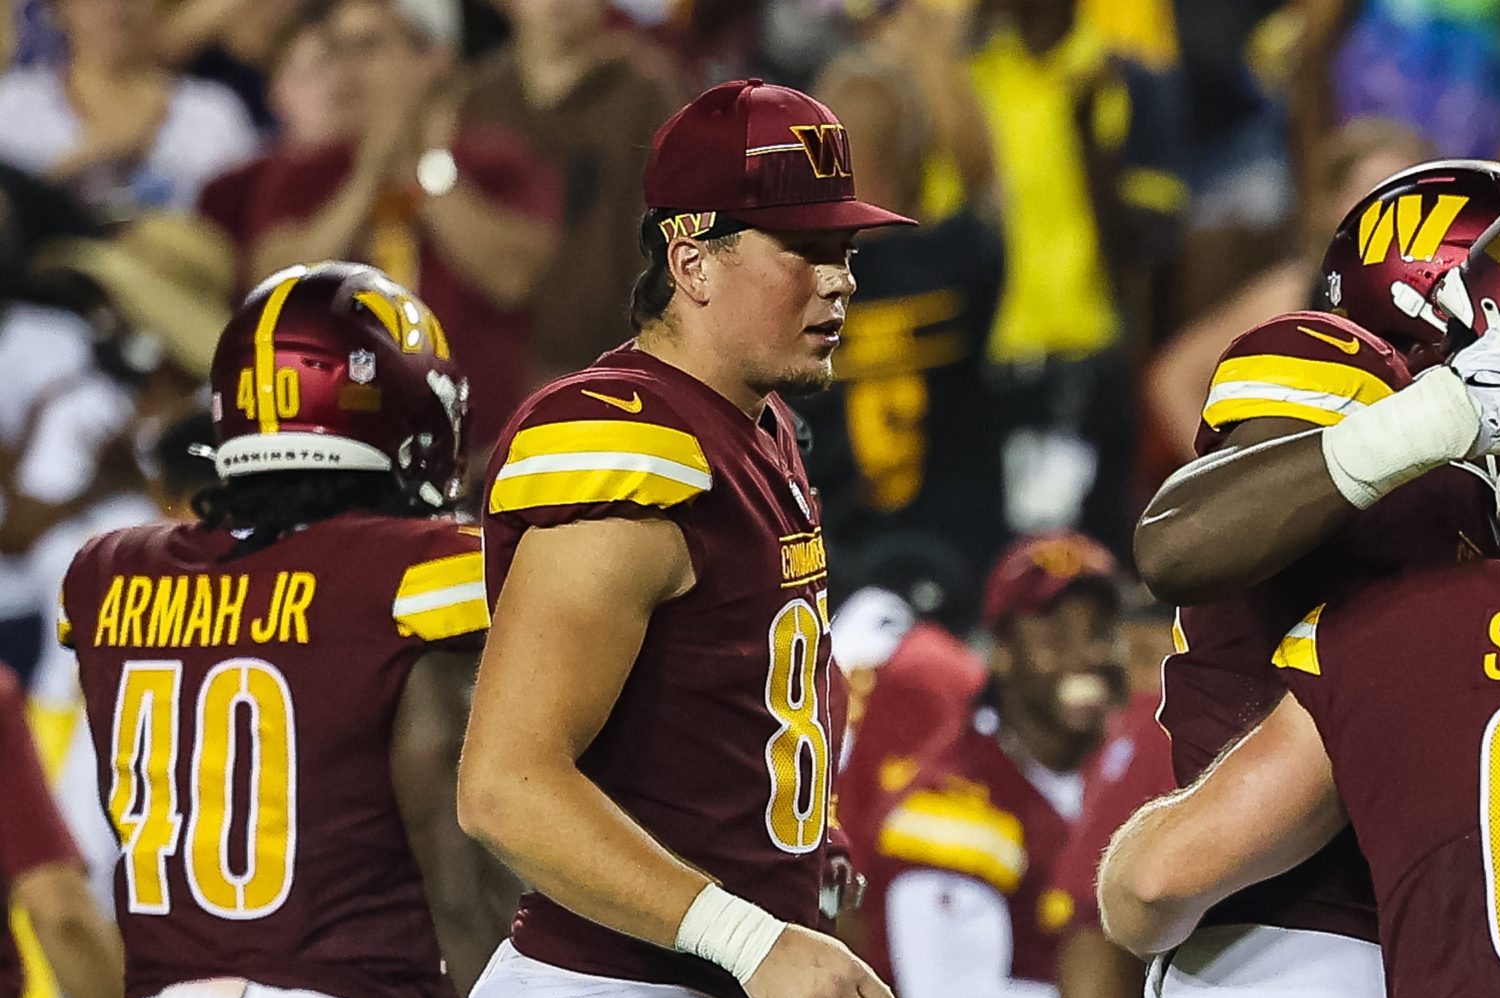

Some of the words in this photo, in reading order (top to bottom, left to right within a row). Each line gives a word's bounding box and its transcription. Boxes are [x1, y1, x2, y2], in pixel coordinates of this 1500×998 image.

[236, 366, 300, 420] 40
[94, 574, 249, 648] ARMAH
[250, 571, 317, 645] JR
[106, 656, 297, 921] 40
[765, 588, 829, 854] 8
